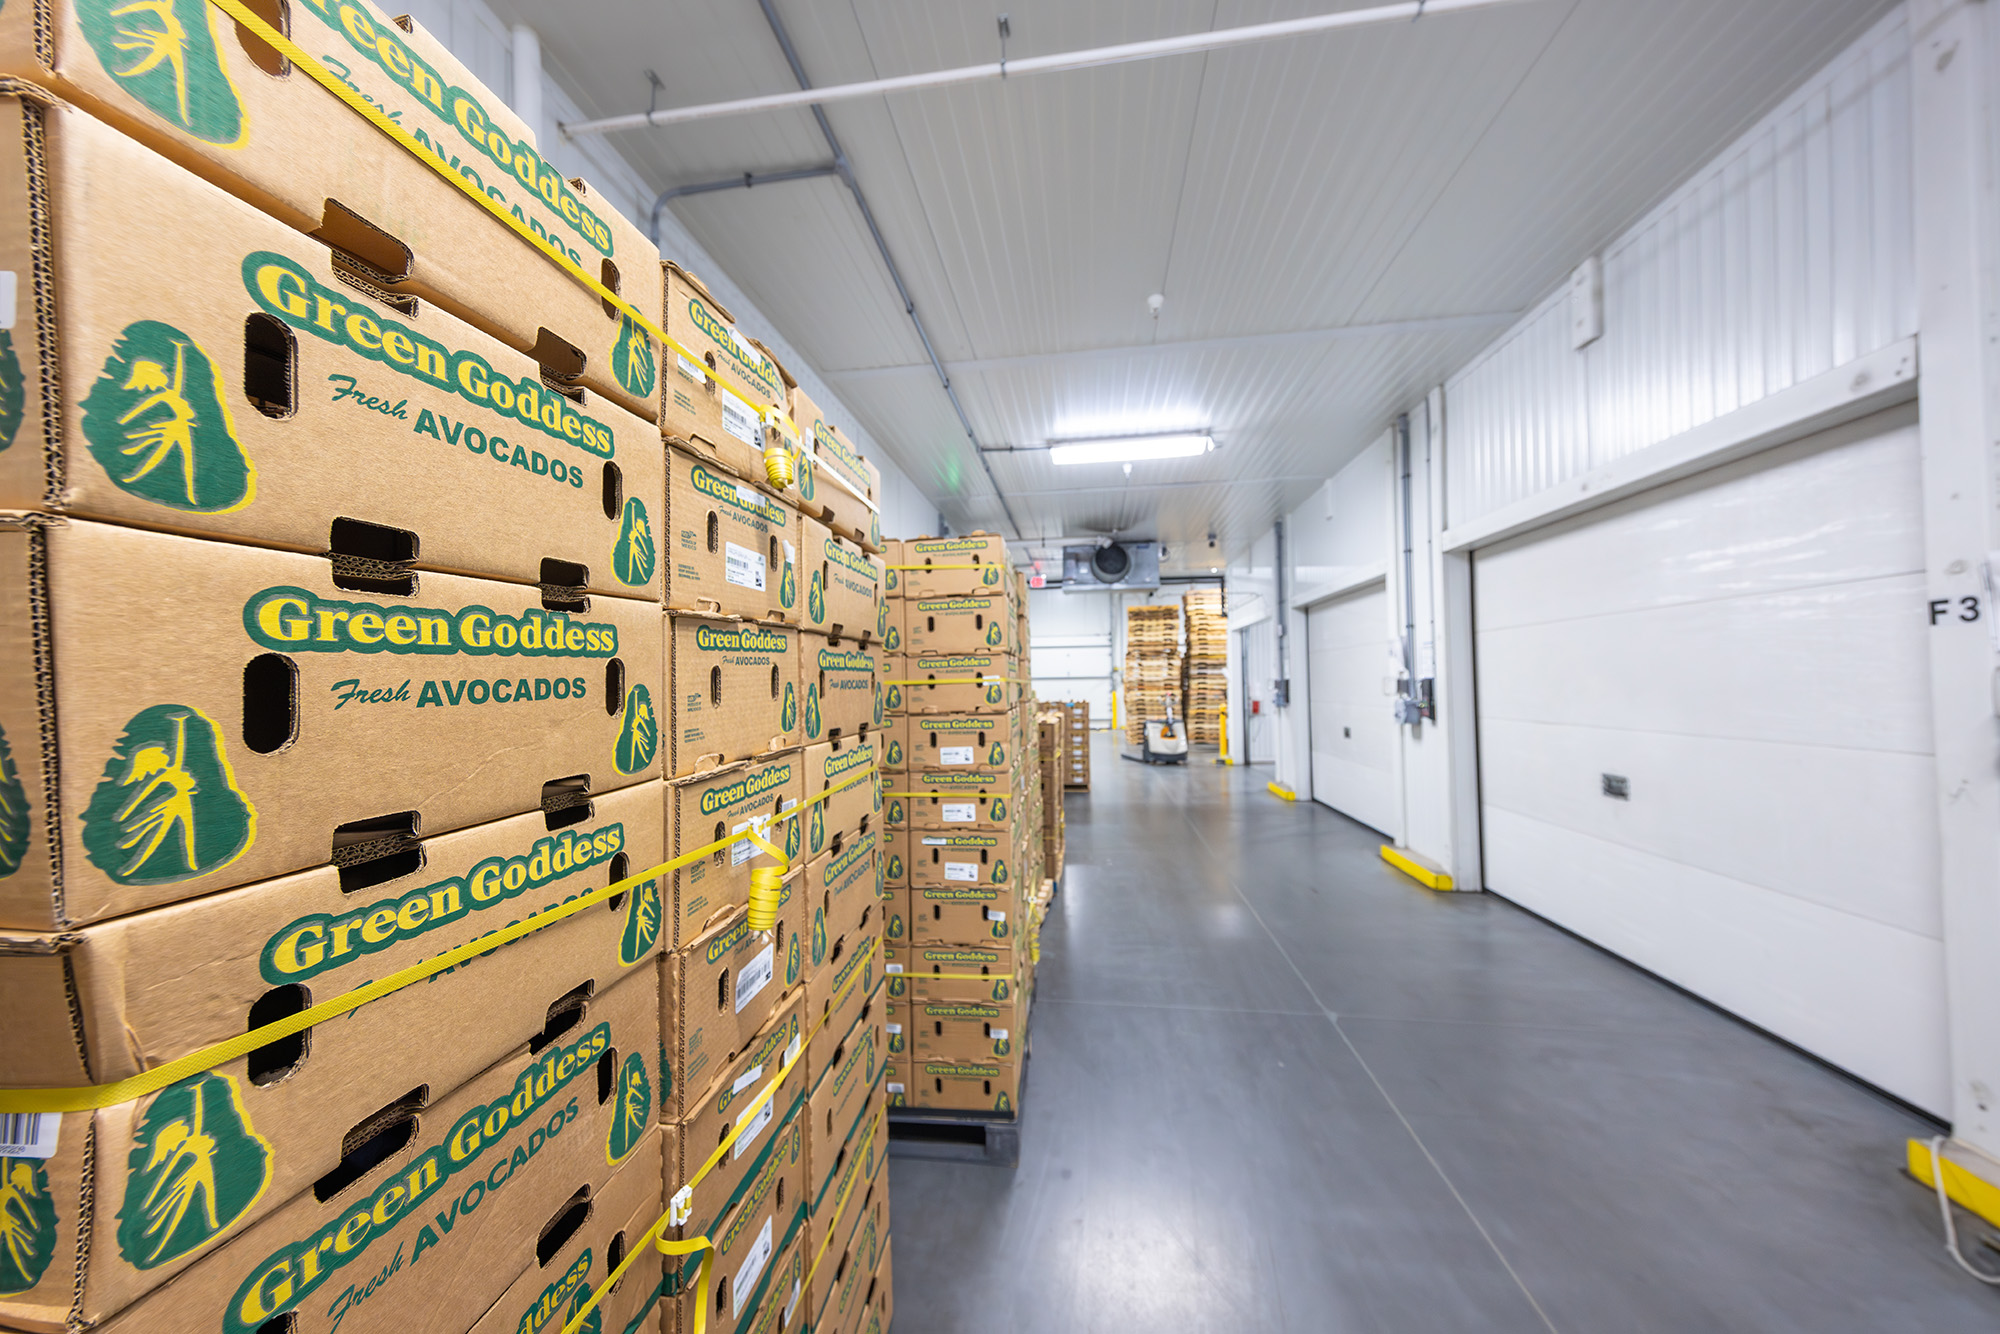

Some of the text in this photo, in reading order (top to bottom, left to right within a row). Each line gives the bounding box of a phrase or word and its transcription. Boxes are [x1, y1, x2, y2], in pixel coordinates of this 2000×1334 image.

[312, 0, 611, 251] een Goddess
[690, 301, 737, 354] Green
[256, 264, 611, 453] Green Goddess
[731, 363, 771, 399] AVOCADOS
[327, 374, 584, 489] Fresh AVOCADOS
[693, 468, 738, 503] Green
[732, 511, 768, 533] AVOCADOS
[915, 539, 987, 553] Green Goddess
[918, 598, 990, 611] Green Goddess
[257, 597, 615, 652] Green Goddess
[697, 628, 787, 651] Green Goddess
[735, 656, 770, 666] AVOCADOS
[819, 652, 845, 668] Green
[918, 657, 990, 669] Green Goddess
[330, 676, 587, 711] Fresh AVOCADOS
[921, 718, 993, 730] Green Goddess
[825, 756, 848, 775] Green
[702, 767, 790, 812] Green Goddess
[923, 773, 995, 784] Green Goddess
[739, 793, 774, 816] AVOCADOS
[954, 836, 997, 846] Goddess
[273, 886, 463, 974] Green
[470, 826, 621, 902] Goddess
[924, 888, 997, 899] Green Goddess
[708, 920, 748, 961] Green
[924, 951, 998, 961] Green Goddess
[926, 1006, 999, 1017] Green Goddess
[926, 1064, 999, 1077] Green Goddess
[240, 1028, 606, 1324] Green Goddess
[327, 1096, 580, 1334] Fresh AVOCADOS
[520, 1256, 589, 1334] ddess
